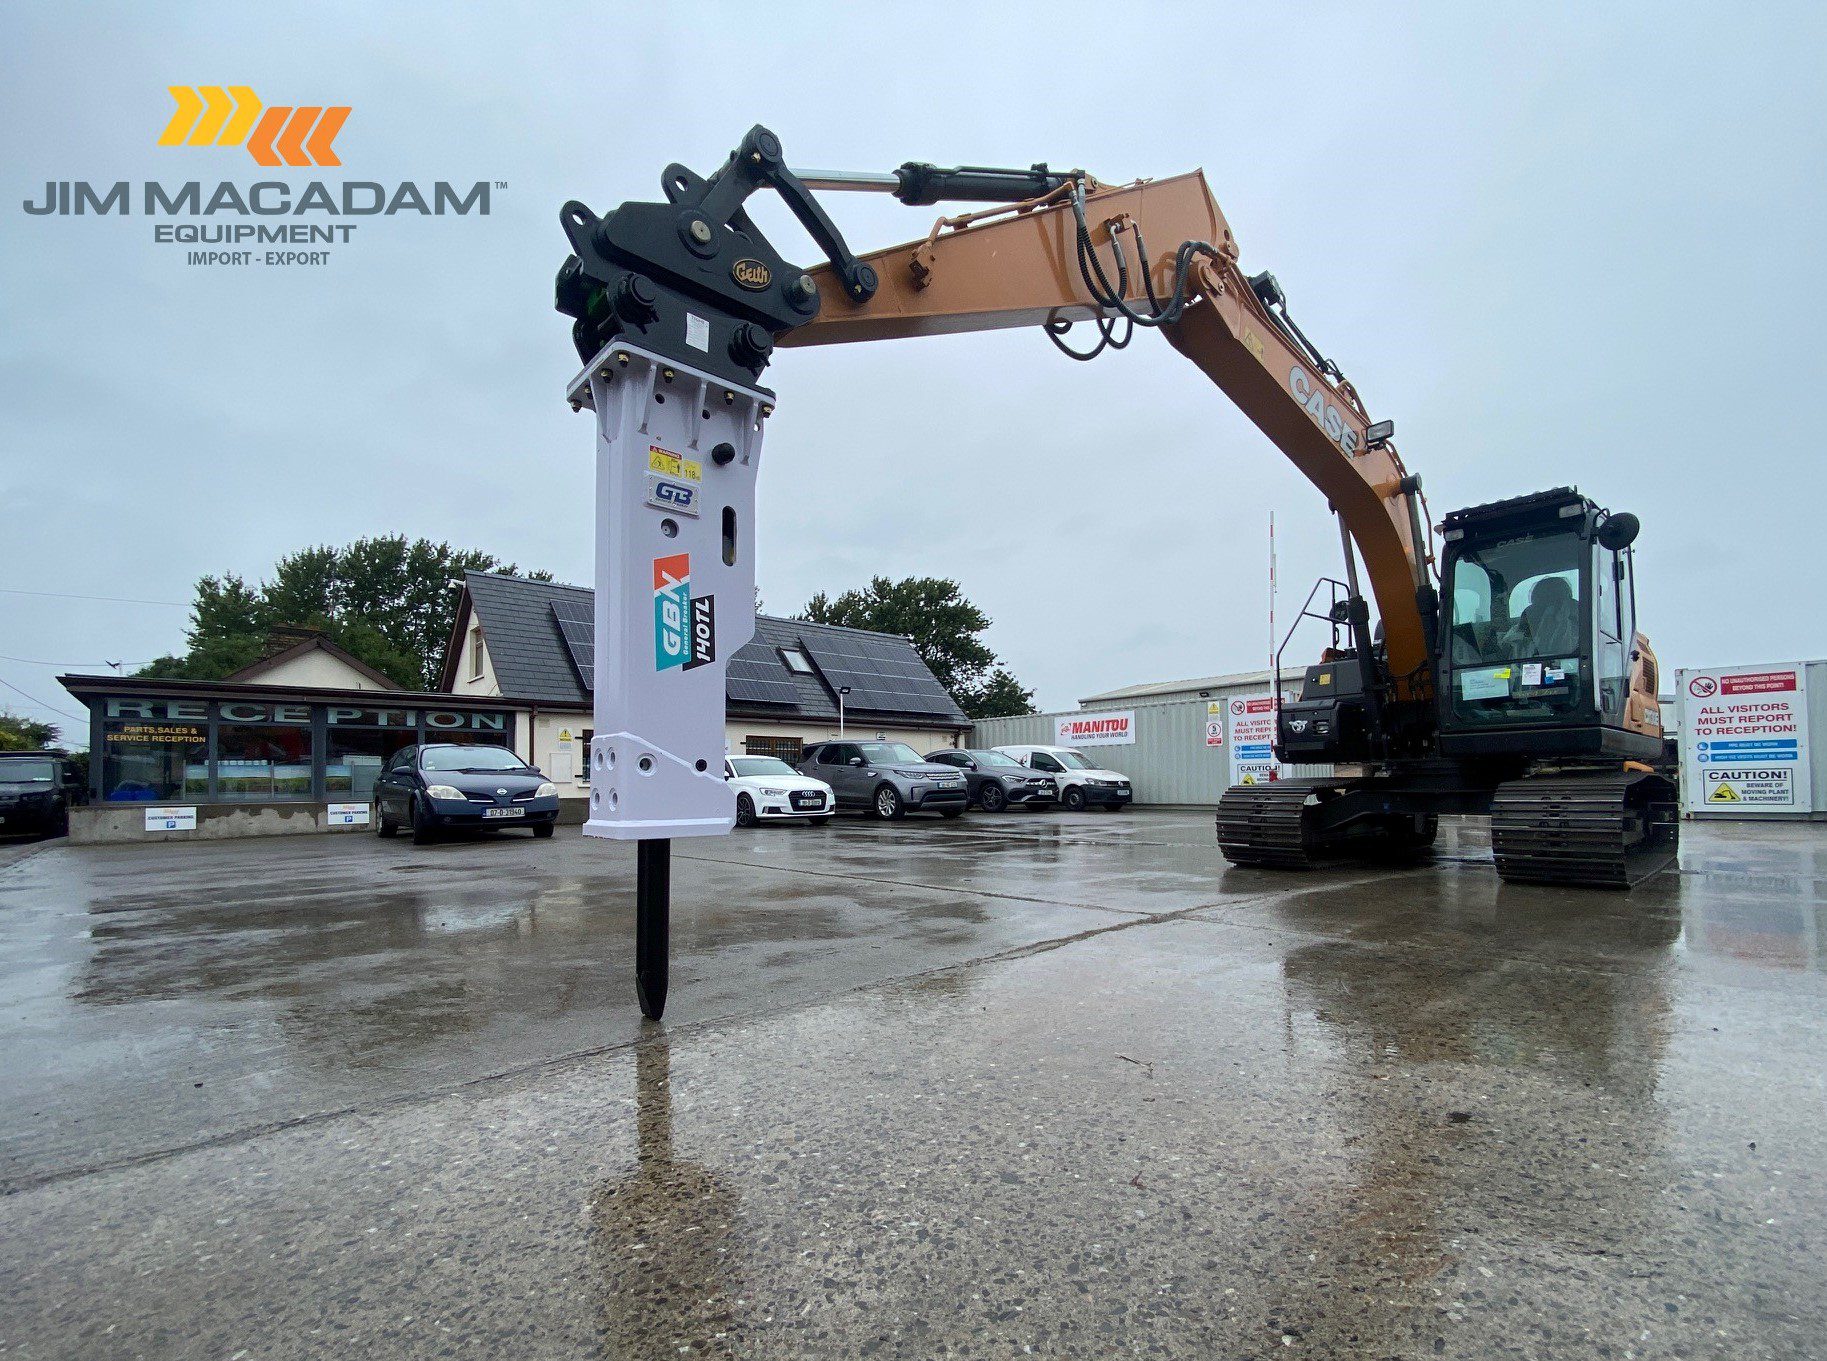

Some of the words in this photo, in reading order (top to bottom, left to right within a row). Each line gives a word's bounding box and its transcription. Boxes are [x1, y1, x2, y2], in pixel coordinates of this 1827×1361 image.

[1289, 365, 1359, 460] CASE
[656, 482, 693, 505] GB
[657, 570, 687, 656] GBX
[695, 598, 711, 662] 140TL
[107, 700, 504, 730] RECEPTION
[1700, 706, 1725, 715] ALL
[1727, 702, 1790, 713] VISITORS
[1072, 718, 1129, 734] MANITOU
[1697, 716, 1735, 726] MUST
[1738, 713, 1794, 724] REPORT
[190, 727, 198, 735] &
[1694, 727, 1713, 736] TO
[1716, 724, 1797, 735] RECEPTION!
[107, 734, 150, 743] SERVICE
[151, 735, 206, 743] RECEPTION
[1708, 770, 1788, 780] CAUTION!
